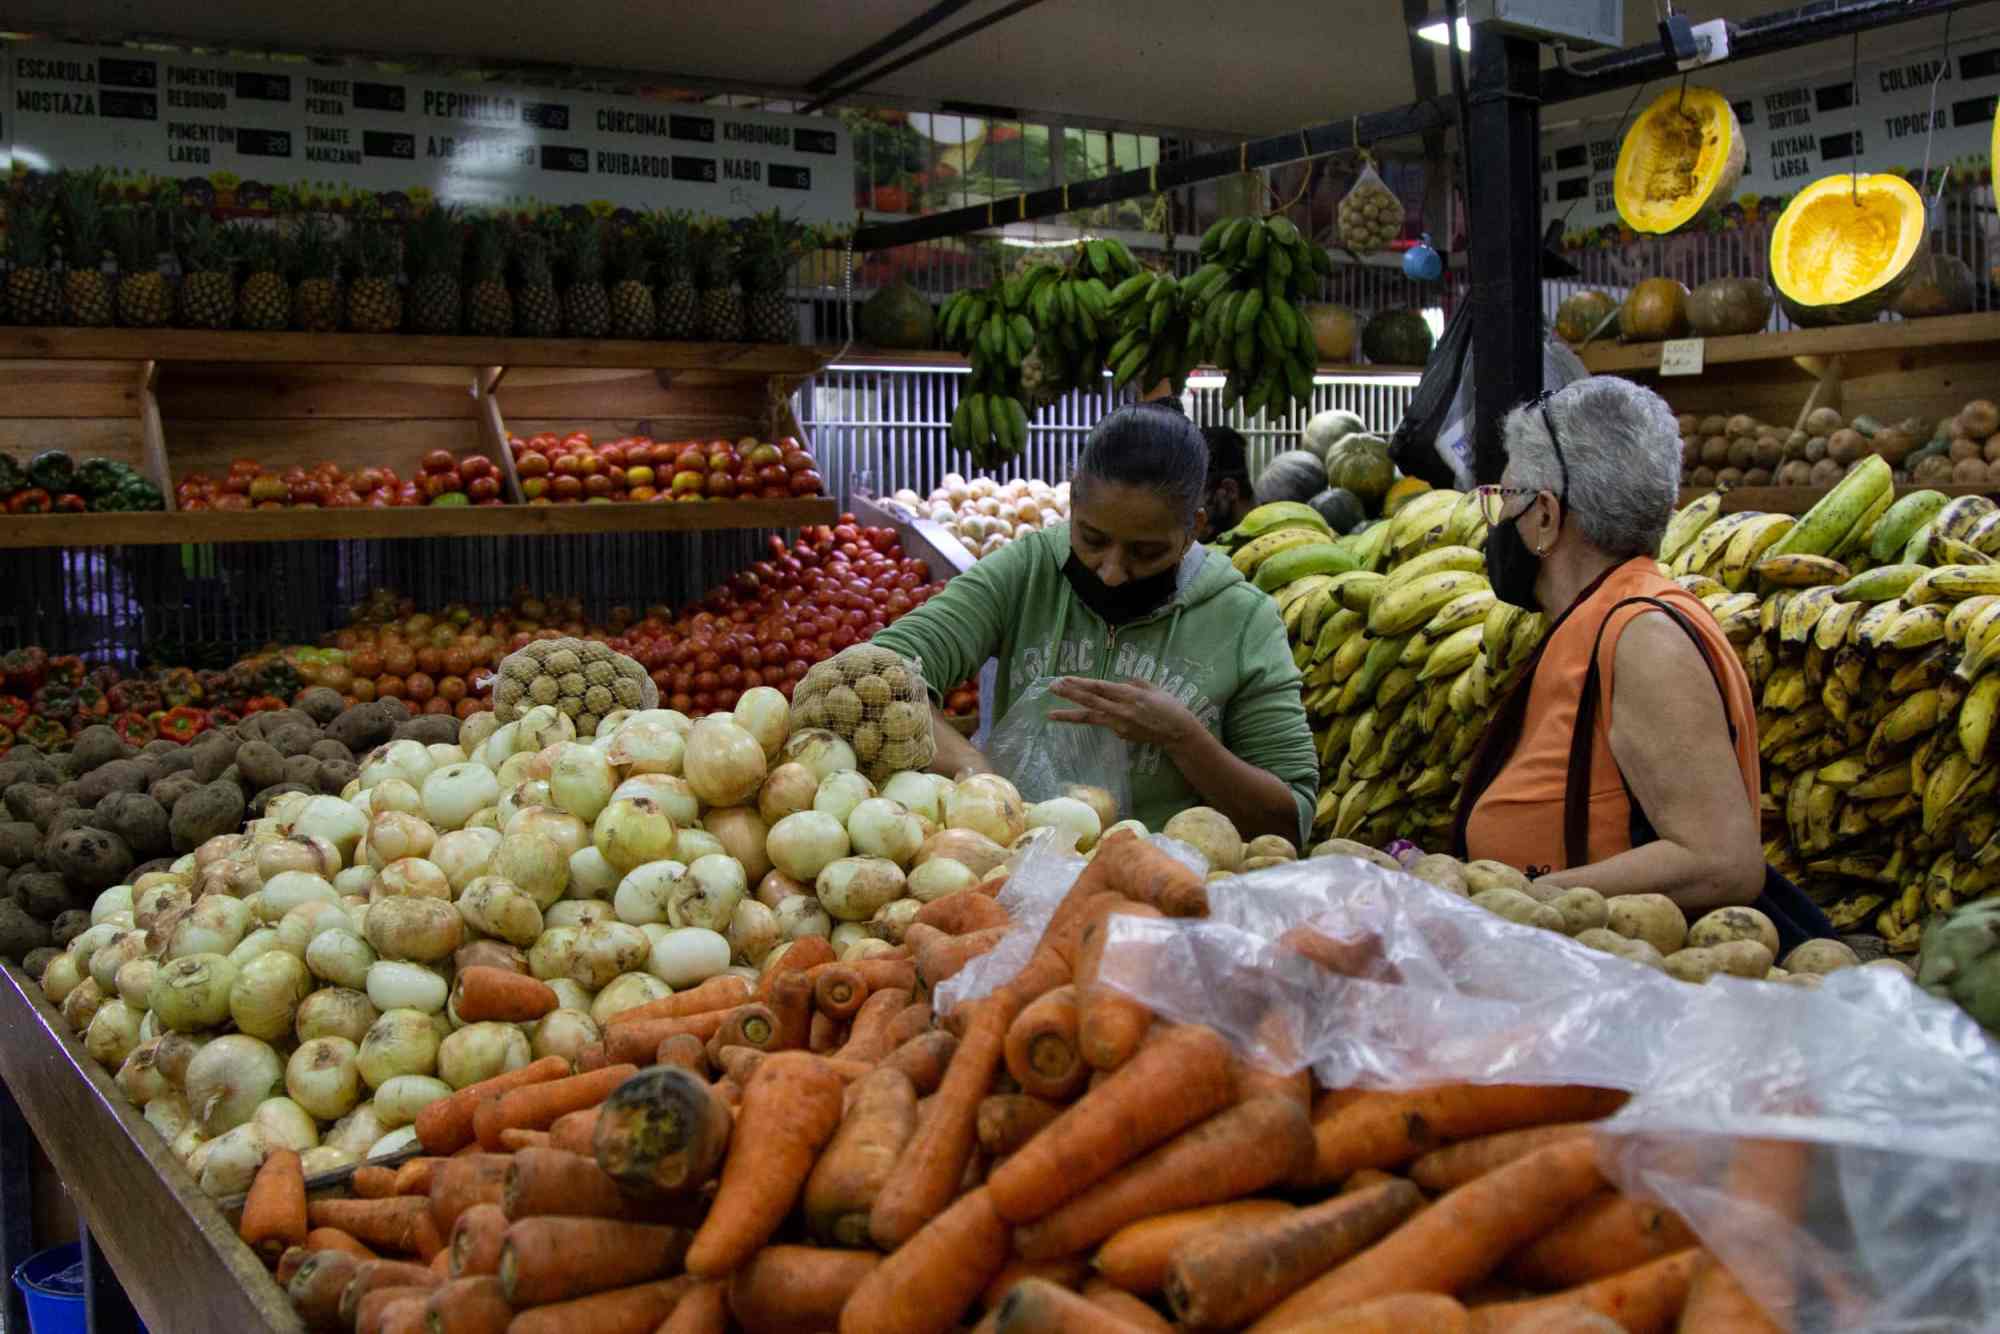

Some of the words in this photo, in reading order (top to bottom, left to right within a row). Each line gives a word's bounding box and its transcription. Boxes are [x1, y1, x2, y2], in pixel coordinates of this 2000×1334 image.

[17, 57, 96, 81] ESCAROLA
[305, 77, 350, 97] TOMATE
[16, 88, 96, 116] MOSTAZA
[305, 99, 344, 115] PERITA
[304, 126, 349, 144] TOMATE
[1770, 133, 1816, 158] AUYAMA
[168, 144, 210, 164] LARGO
[305, 146, 361, 165] MANZANO
[724, 159, 760, 181] NABO
[1772, 157, 1809, 180] LARGA
